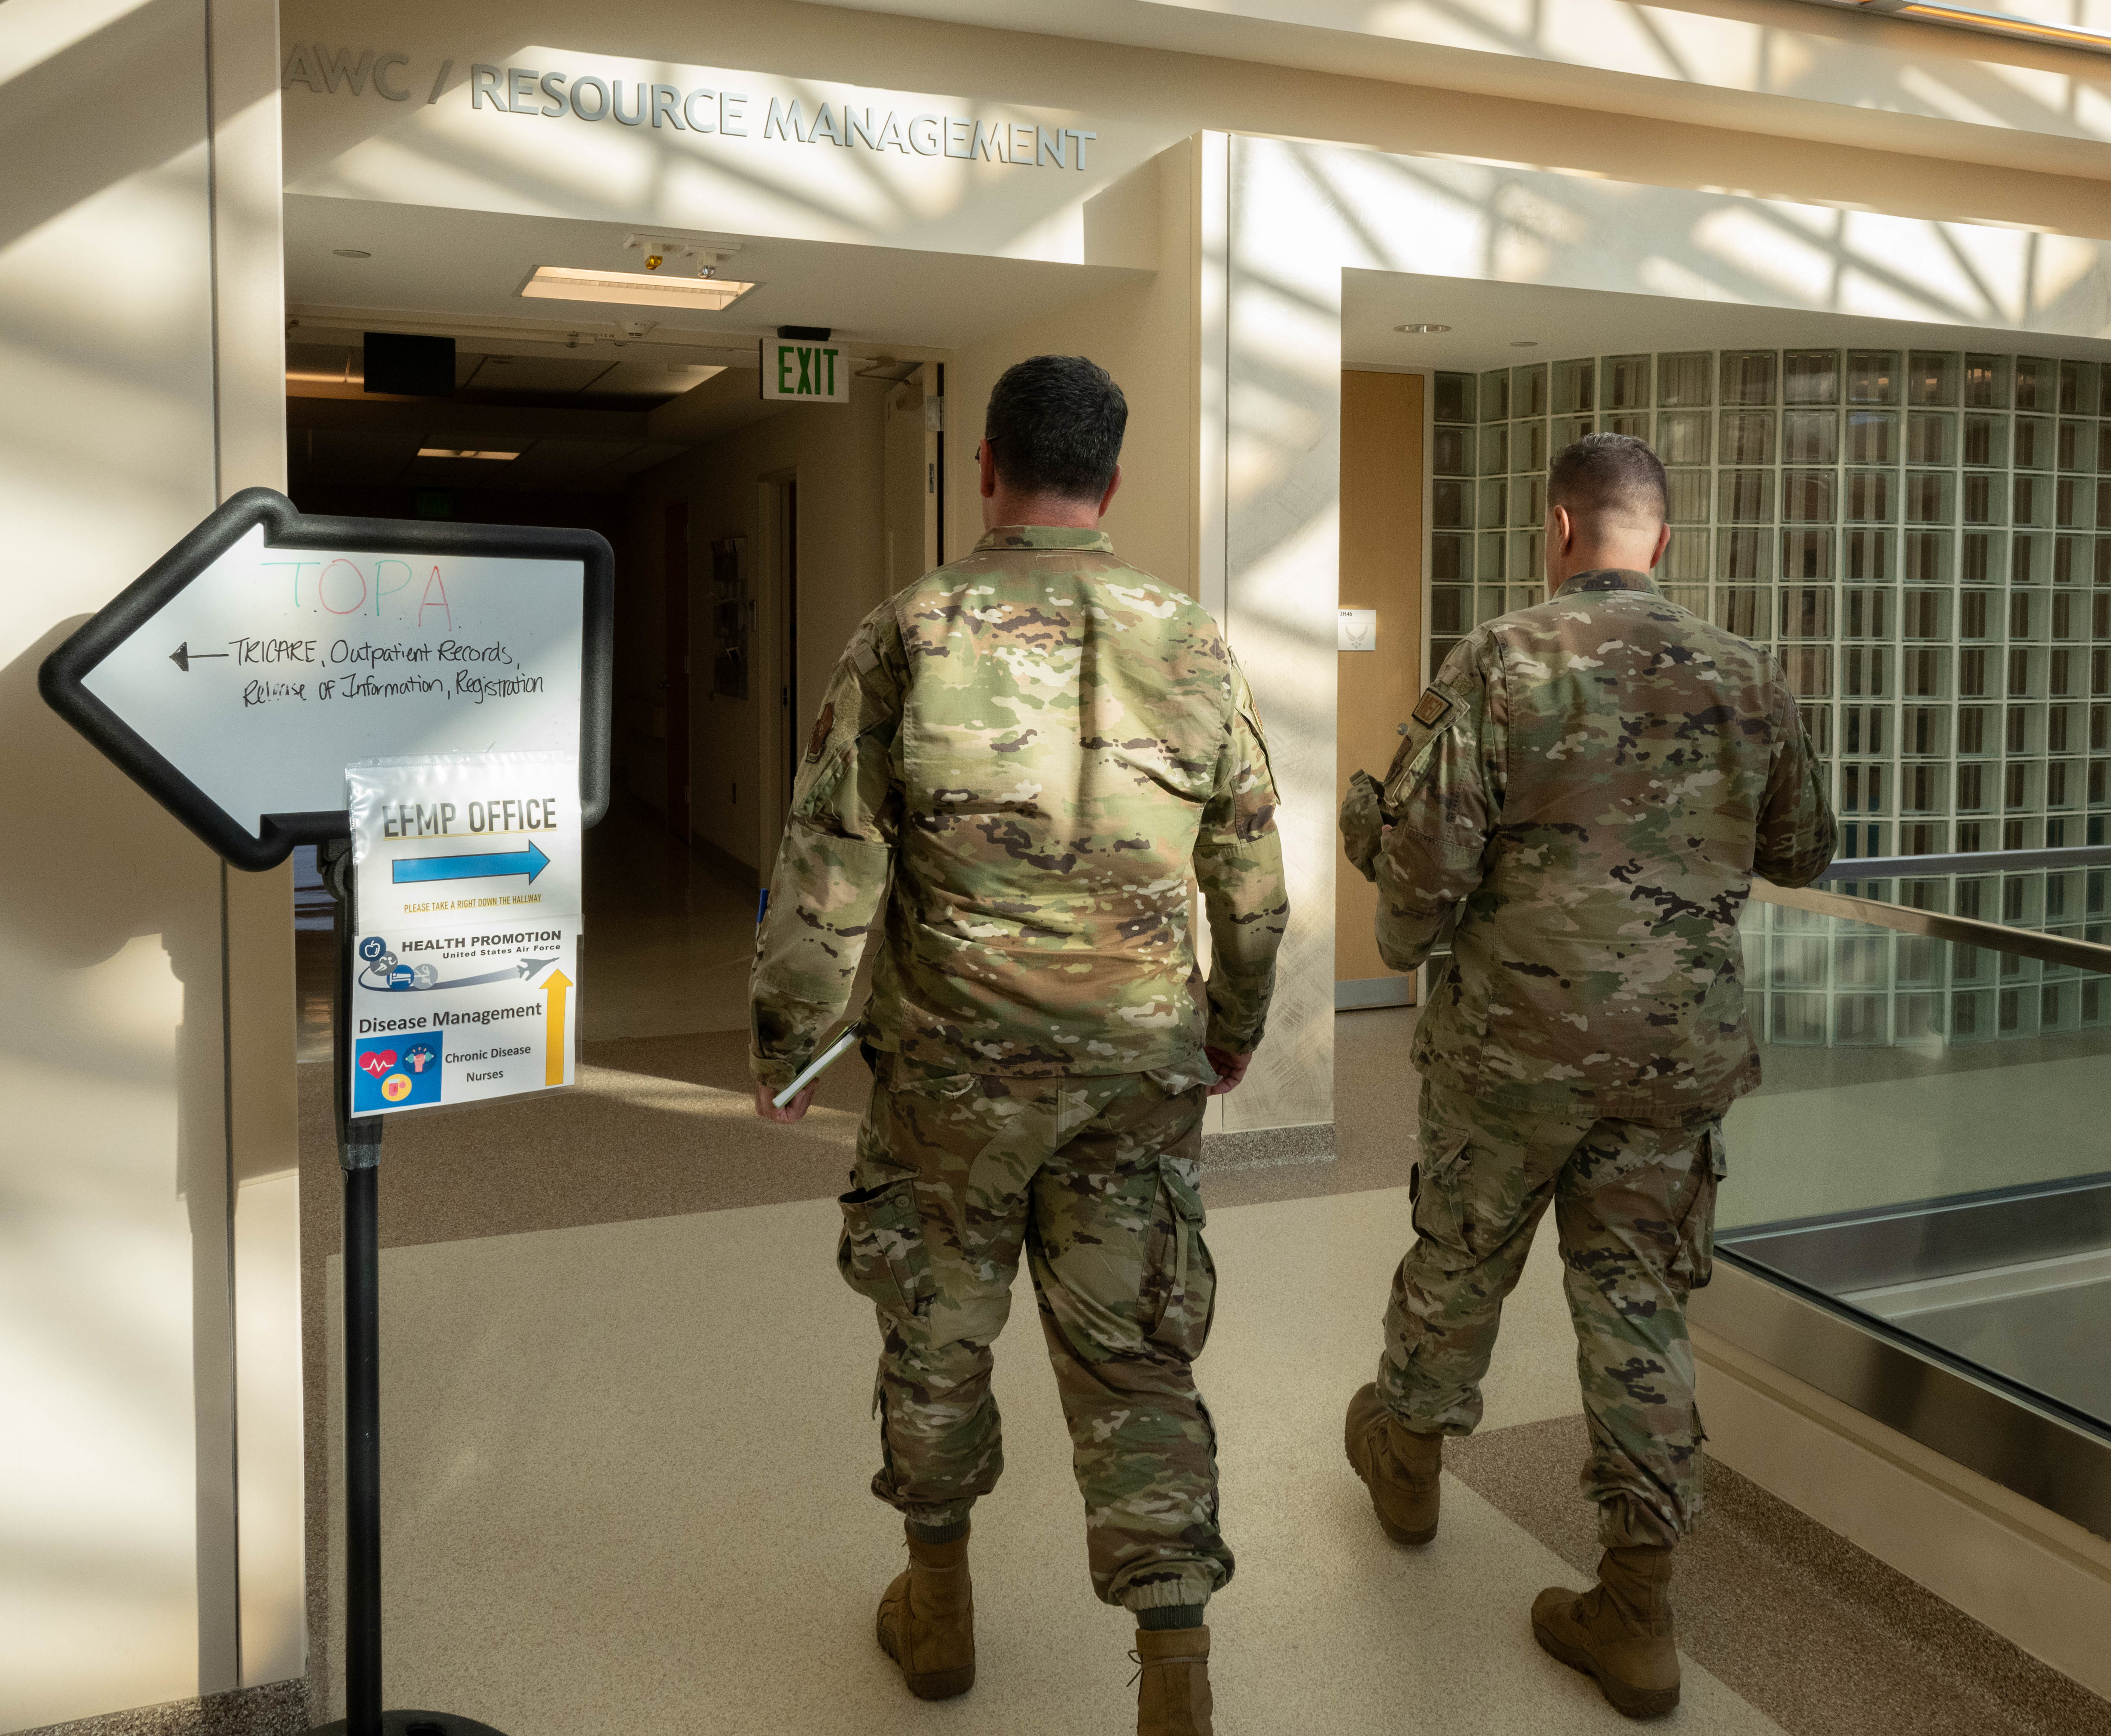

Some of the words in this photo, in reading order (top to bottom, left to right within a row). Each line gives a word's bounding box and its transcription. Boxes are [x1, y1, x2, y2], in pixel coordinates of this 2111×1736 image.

[281, 43, 411, 101] AWC
[427, 58, 453, 104] /
[472, 64, 748, 137] RESOURCE
[764, 97, 1097, 170] MANAGEMENT
[778, 346, 838, 396] EXIT
[229, 637, 325, 667] TRICARE,
[331, 639, 432, 669] Outpatient
[438, 640, 520, 670] Records,
[340, 673, 451, 700] Information,
[456, 669, 544, 704] Registration
[382, 802, 457, 838] EFMP
[469, 798, 557, 833] OFFICE
[404, 903, 430, 913] PLEASE
[432, 901, 449, 910] TAKE
[451, 901, 455, 909] A
[457, 899, 476, 908] RIGHT
[478, 897, 497, 906] DOWN
[499, 896, 510, 905] THE
[512, 893, 541, 903] HALLWAY
[402, 937, 466, 952] HEALTH
[471, 930, 561, 947] PROMOTION
[443, 950, 476, 959] United
[480, 948, 511, 956] States
[359, 1013, 427, 1034] Disease
[433, 1002, 542, 1026] Management
[445, 1050, 488, 1063] Chronic
[491, 1045, 531, 1058] Disease
[466, 1069, 504, 1082] Nurses
